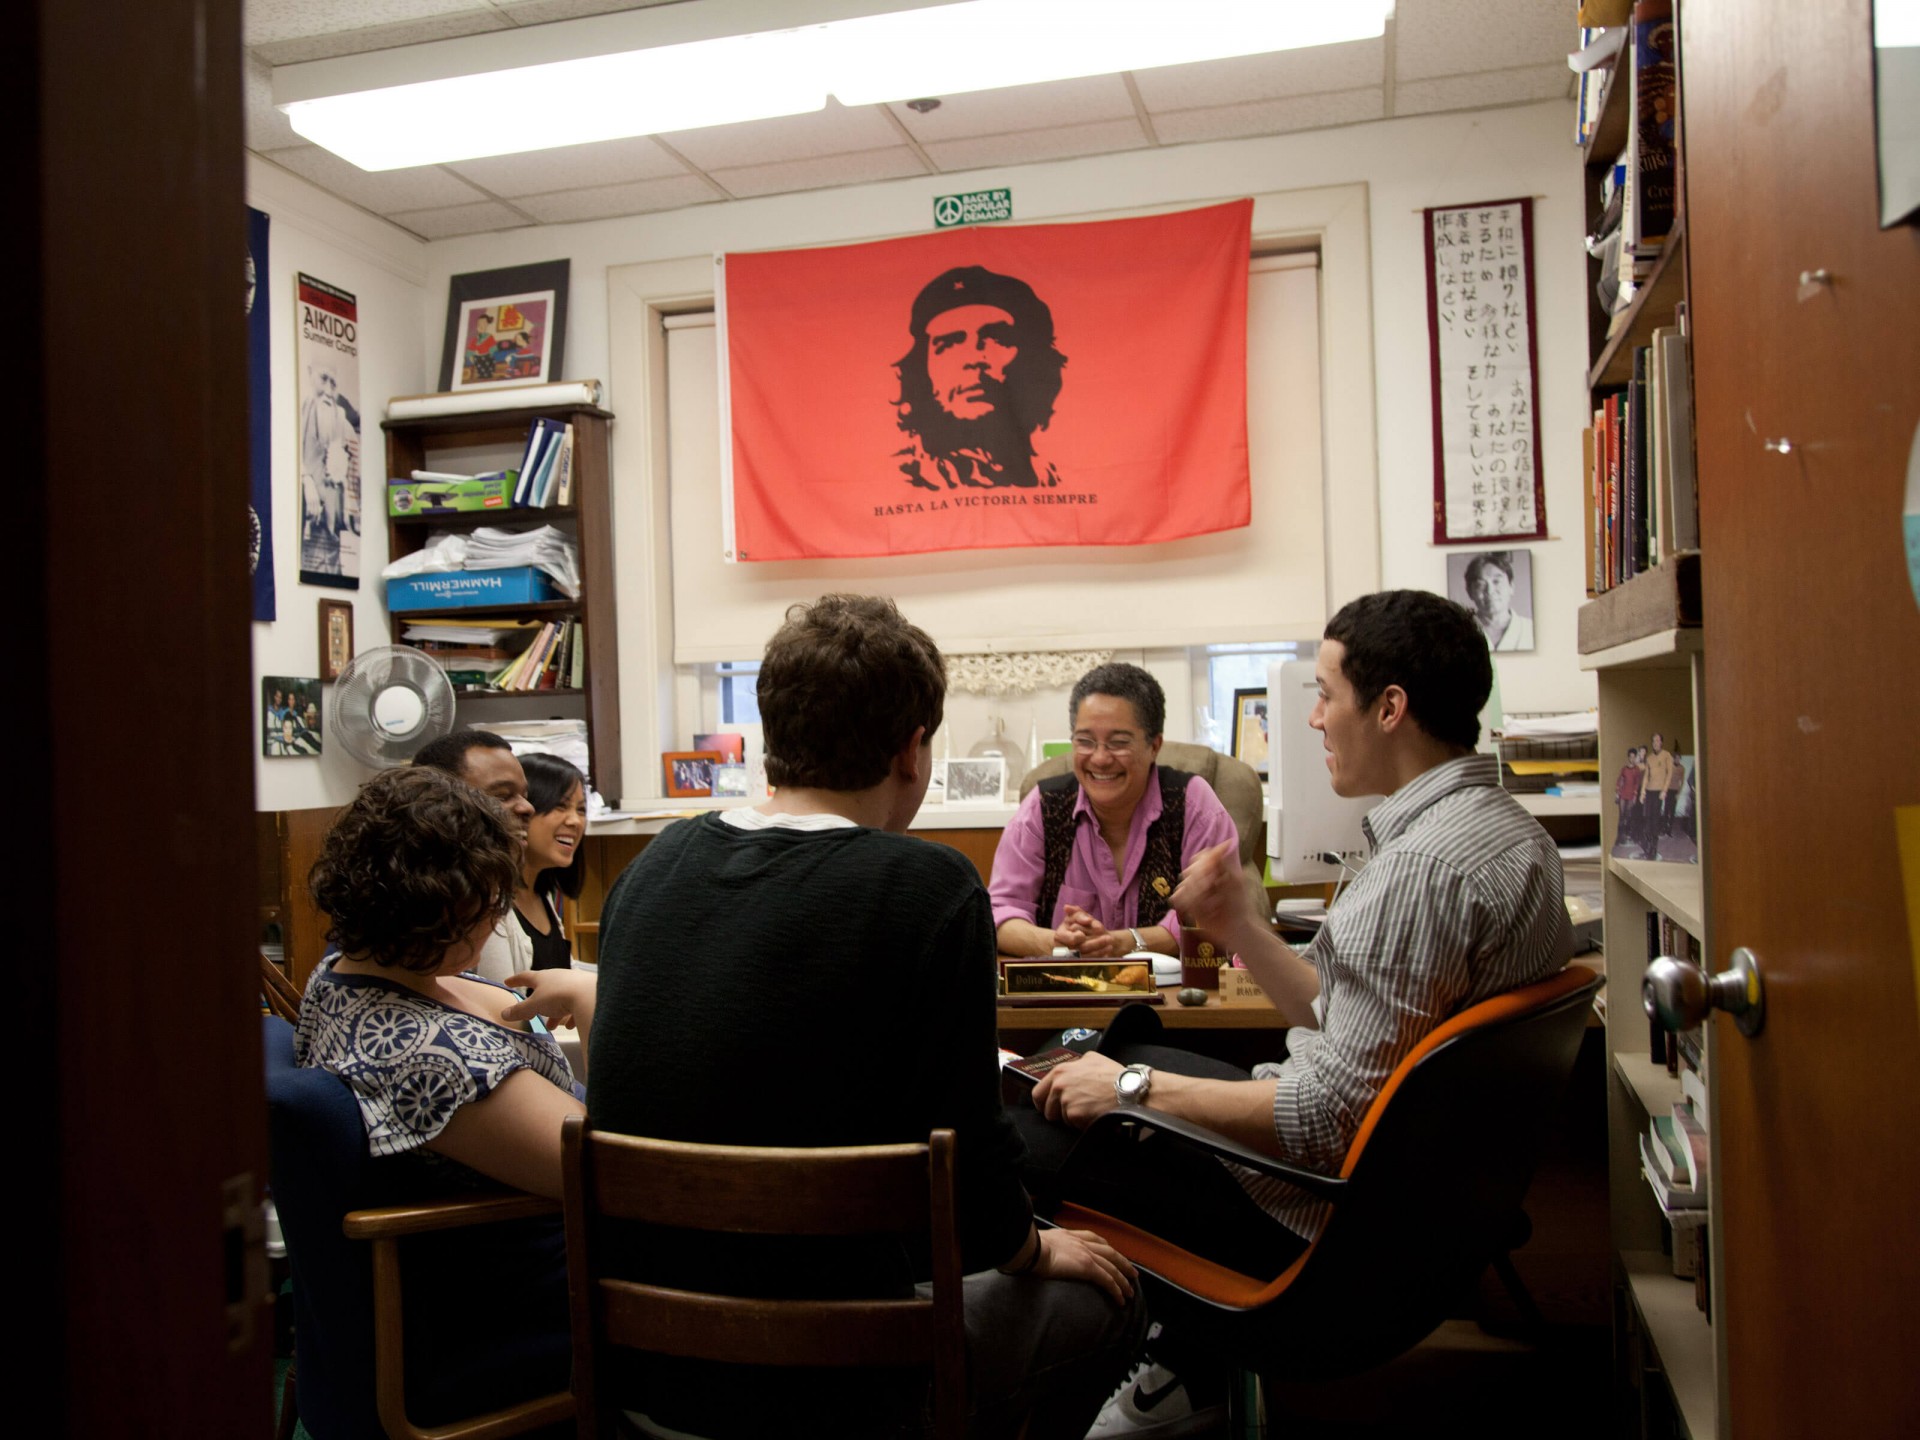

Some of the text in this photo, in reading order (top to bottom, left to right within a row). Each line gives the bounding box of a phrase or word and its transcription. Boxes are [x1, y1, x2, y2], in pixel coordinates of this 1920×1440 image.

[962, 190, 1006, 204] BACK BY
[963, 199, 1010, 213] POPULAR
[963, 209, 1009, 222] DEMAND
[304, 305, 356, 343] AIKIDO
[303, 327, 358, 357] Summer Camp
[874, 493, 1099, 517] HASTA LA VICTORIA SIEMPRE
[408, 576, 502, 592] HAMMERMILL
